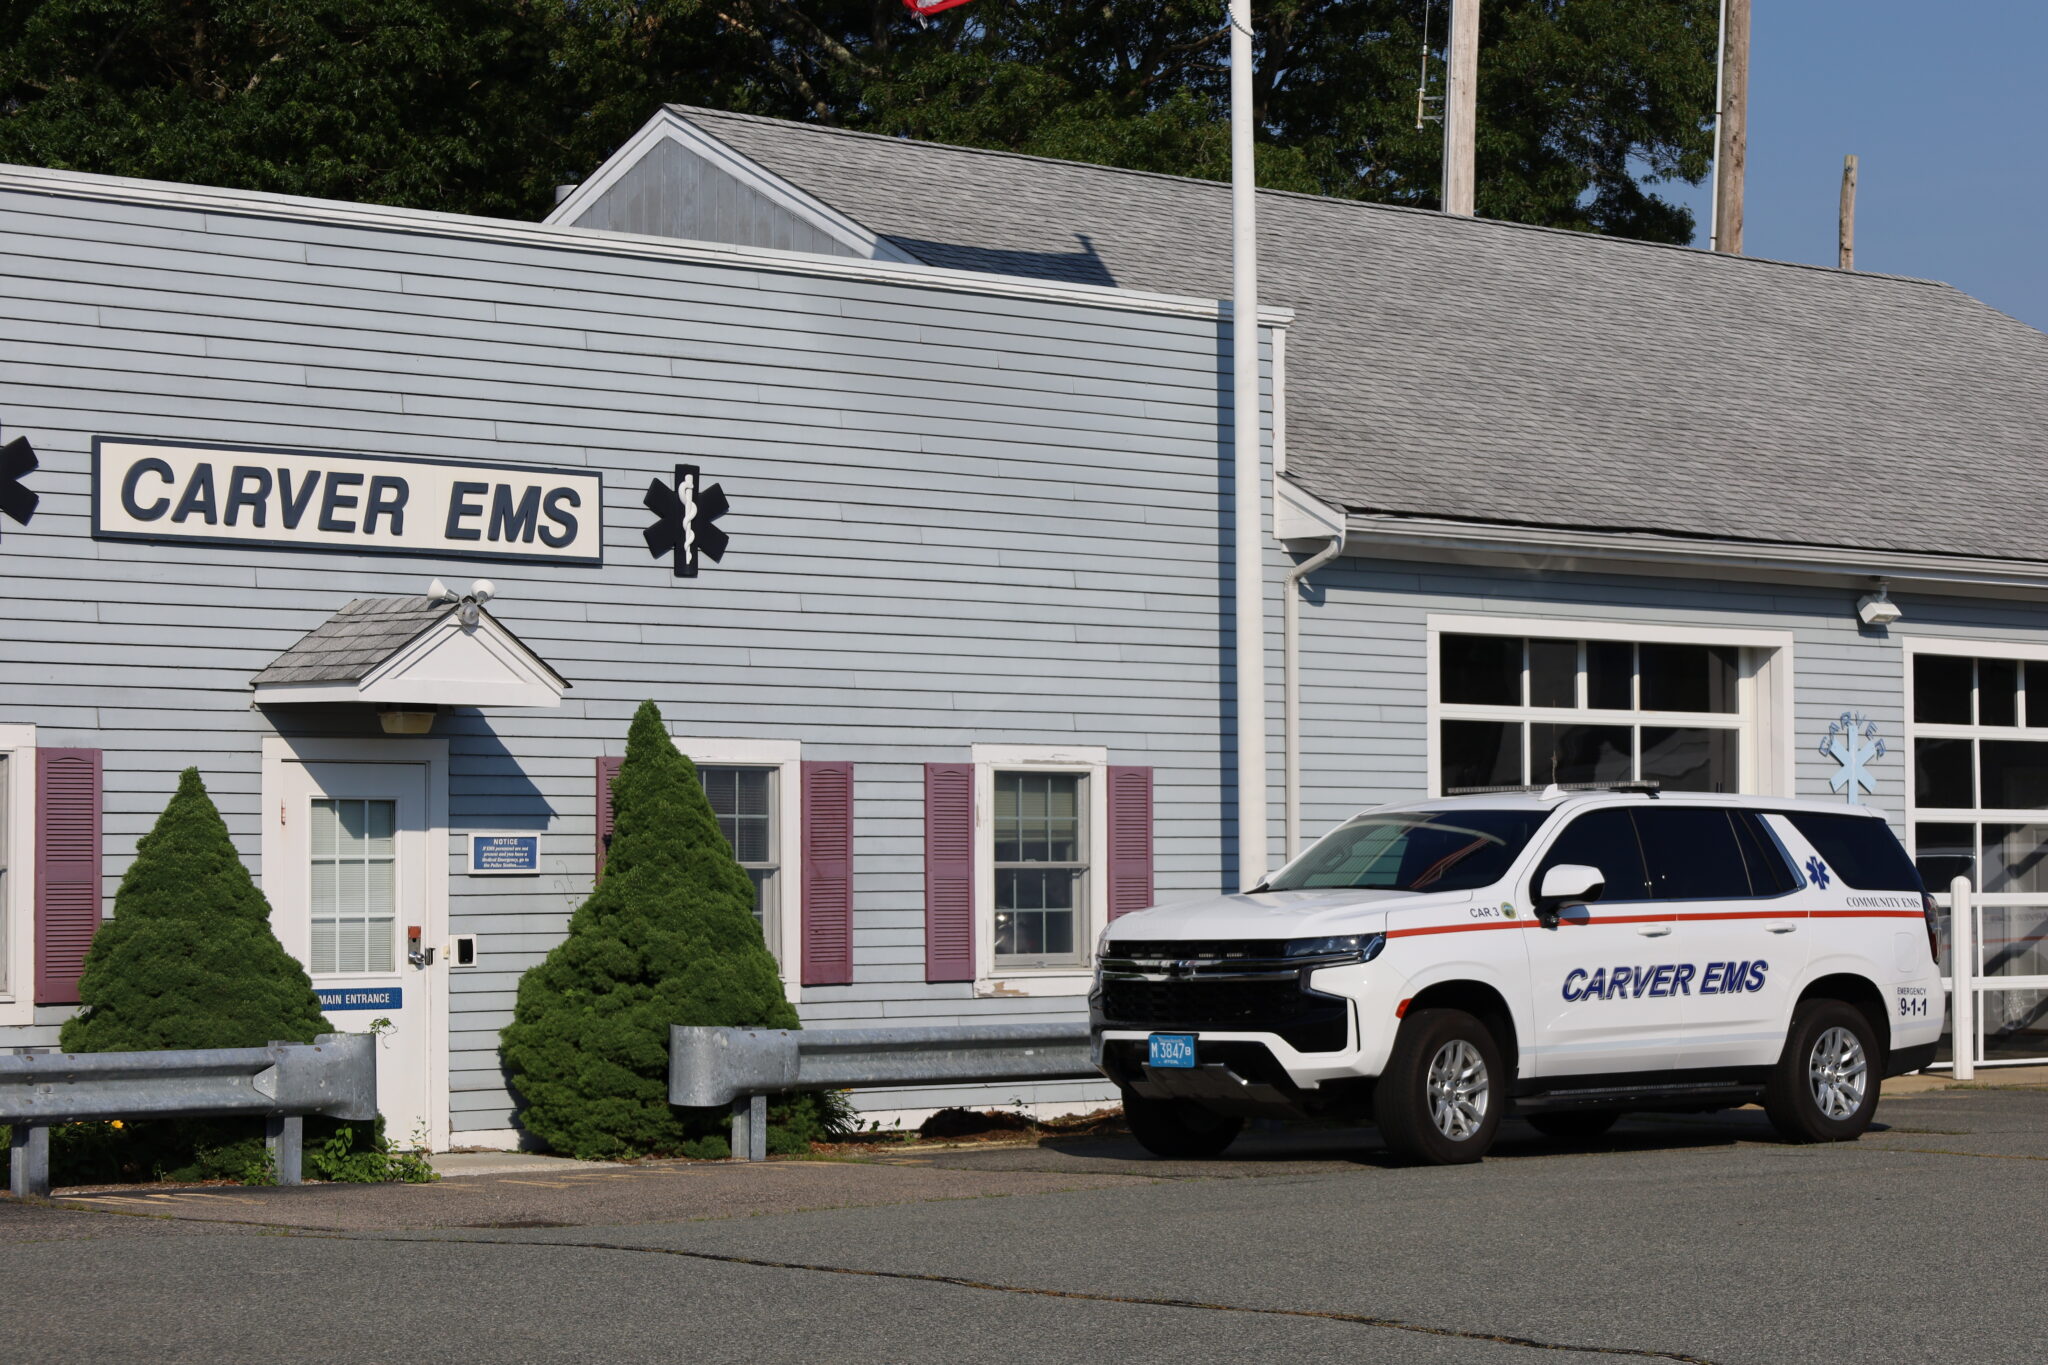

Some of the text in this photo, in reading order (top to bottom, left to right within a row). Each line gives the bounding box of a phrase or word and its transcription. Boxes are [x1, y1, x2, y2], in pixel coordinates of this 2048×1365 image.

[121, 457, 581, 548] CARVER EMS
[1818, 711, 1886, 761] CARVER
[1846, 897, 1920, 908] COMMUNITY EMS
[1470, 906, 1500, 918] CAR 3
[1562, 960, 1768, 1002] CARVER EMS
[1897, 986, 1927, 996] EMERGENCY
[319, 993, 390, 1005] MAIN ENTRANCE
